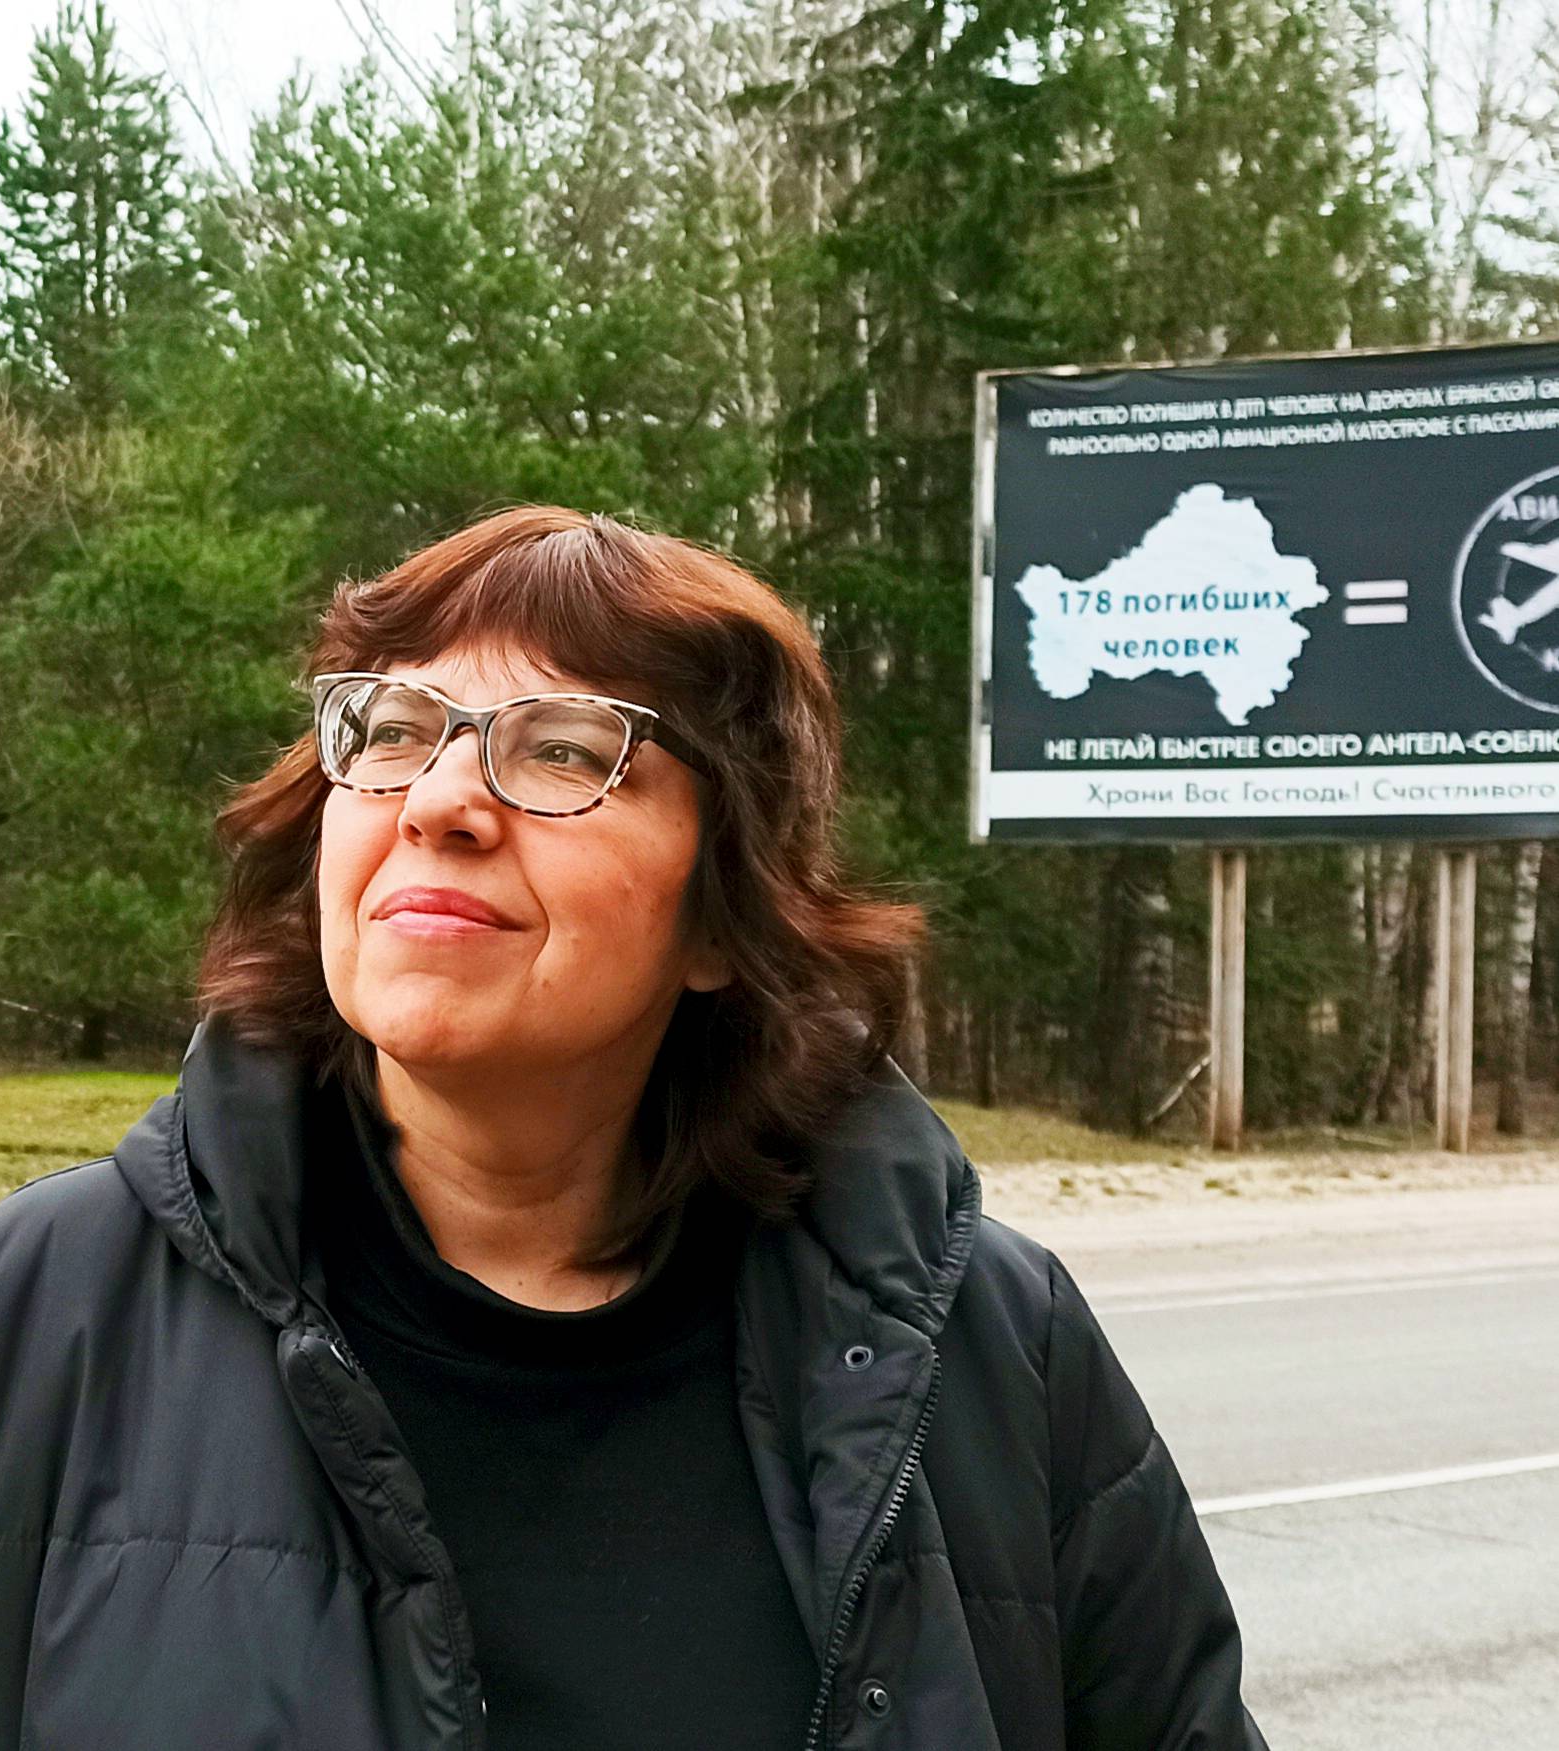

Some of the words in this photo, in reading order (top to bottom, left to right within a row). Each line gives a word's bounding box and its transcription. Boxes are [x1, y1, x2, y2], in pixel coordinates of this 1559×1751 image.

[1028, 405, 1129, 428] КОЛИЧЕСТВО
[1130, 400, 1219, 424] ПОГИБШИХ
[1219, 399, 1232, 419] В
[1233, 397, 1266, 420] ДТП
[1267, 392, 1339, 417] ЧЕЛОВЕК
[1340, 391, 1366, 413] НА
[1366, 386, 1445, 413] ДОРОГАХ
[1047, 432, 1160, 455] РАВНОСИЛЬНО
[1161, 425, 1220, 453] ОДНОЙ
[1221, 418, 1345, 448] АВИАЦИОННОЙ
[1452, 415, 1467, 436] С
[1058, 589, 1112, 615] 178
[1123, 584, 1291, 614] погибших
[1103, 636, 1240, 659] человек
[1045, 738, 1077, 761] НЕ
[1080, 733, 1156, 760] ЛЕТАЙ
[1159, 736, 1261, 760] БЫСТРЕЕ
[1263, 734, 1363, 758] СВОЕГО
[1087, 781, 1173, 810] Храни
[1185, 781, 1229, 804] Вас
[1242, 779, 1360, 804] Господь!
[1372, 778, 1556, 801] Счастливого
